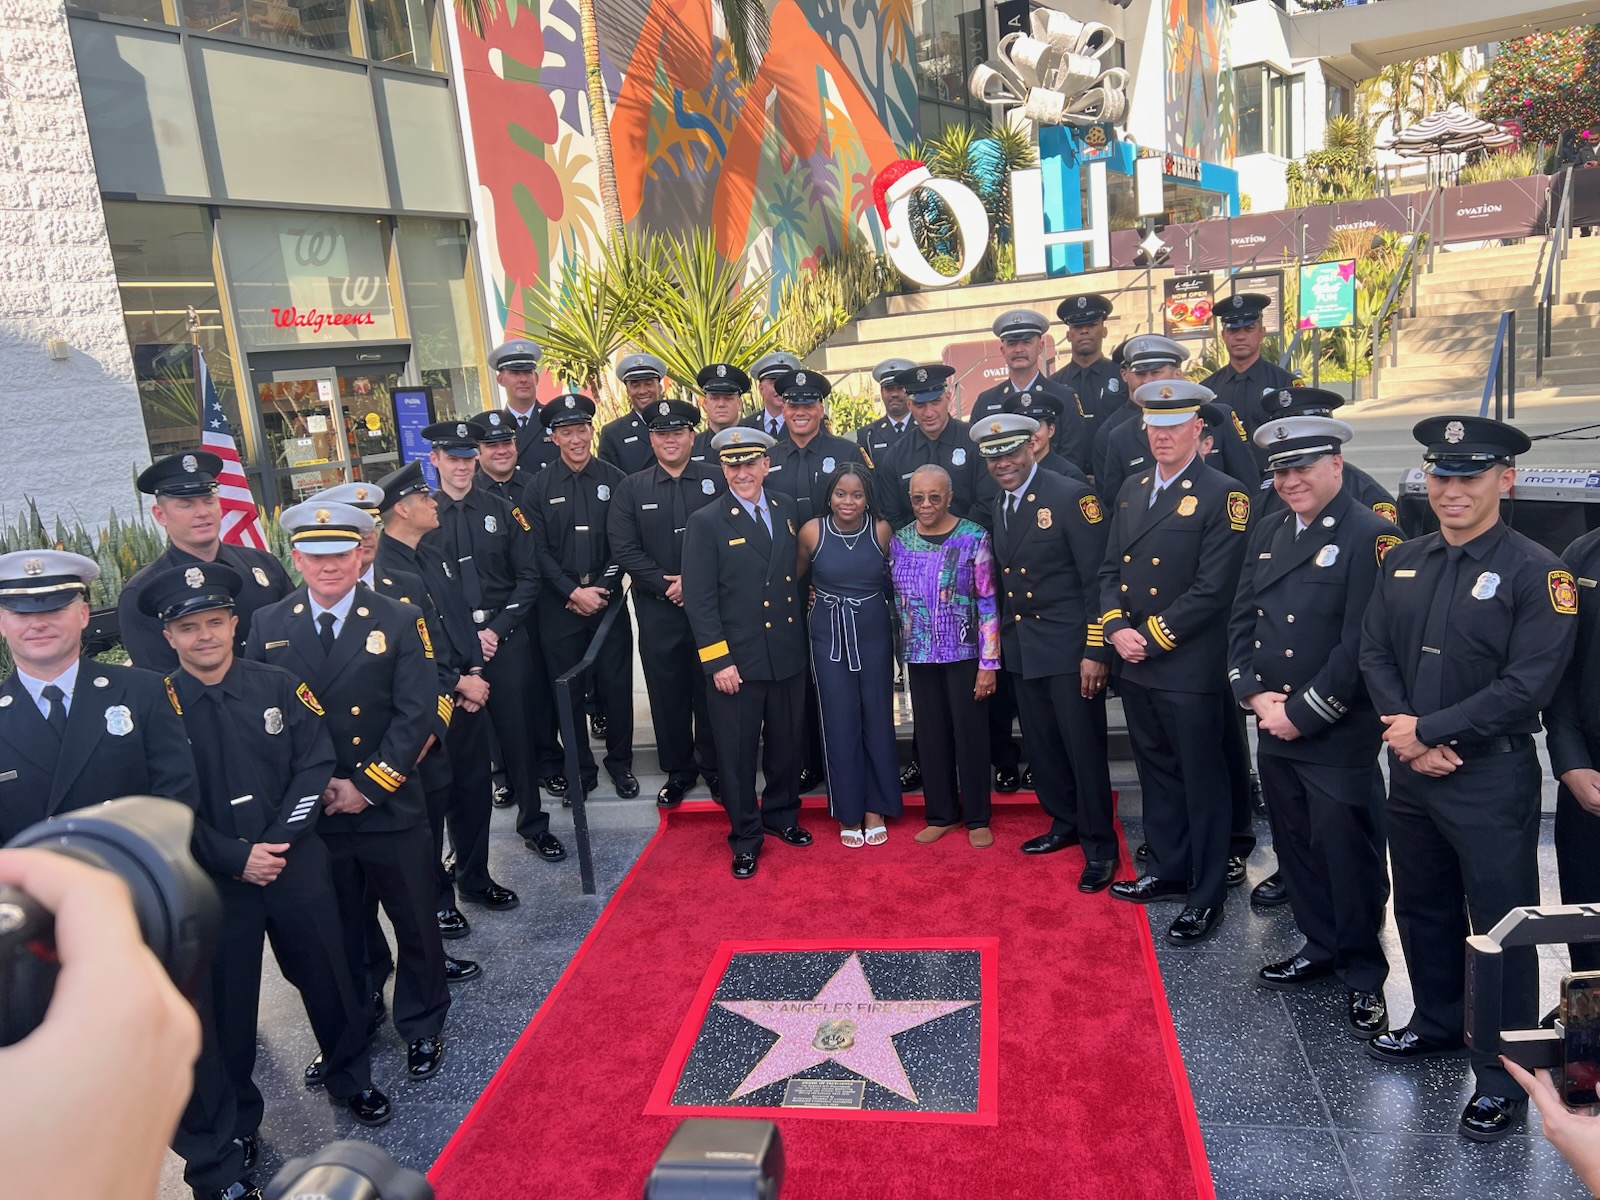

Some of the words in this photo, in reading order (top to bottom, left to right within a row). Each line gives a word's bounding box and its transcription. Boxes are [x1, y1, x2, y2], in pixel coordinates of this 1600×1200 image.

[1457, 203, 1503, 216] OVATION
[1335, 219, 1376, 231] OVATION
[271, 306, 375, 333] Walgreens
[983, 364, 1010, 378] OVATI
[1524, 476, 1587, 484] MOTIF
[744, 1003, 774, 1014] LOS
[779, 1003, 853, 1014] ANGELES
[857, 1003, 892, 1014] FIRE
